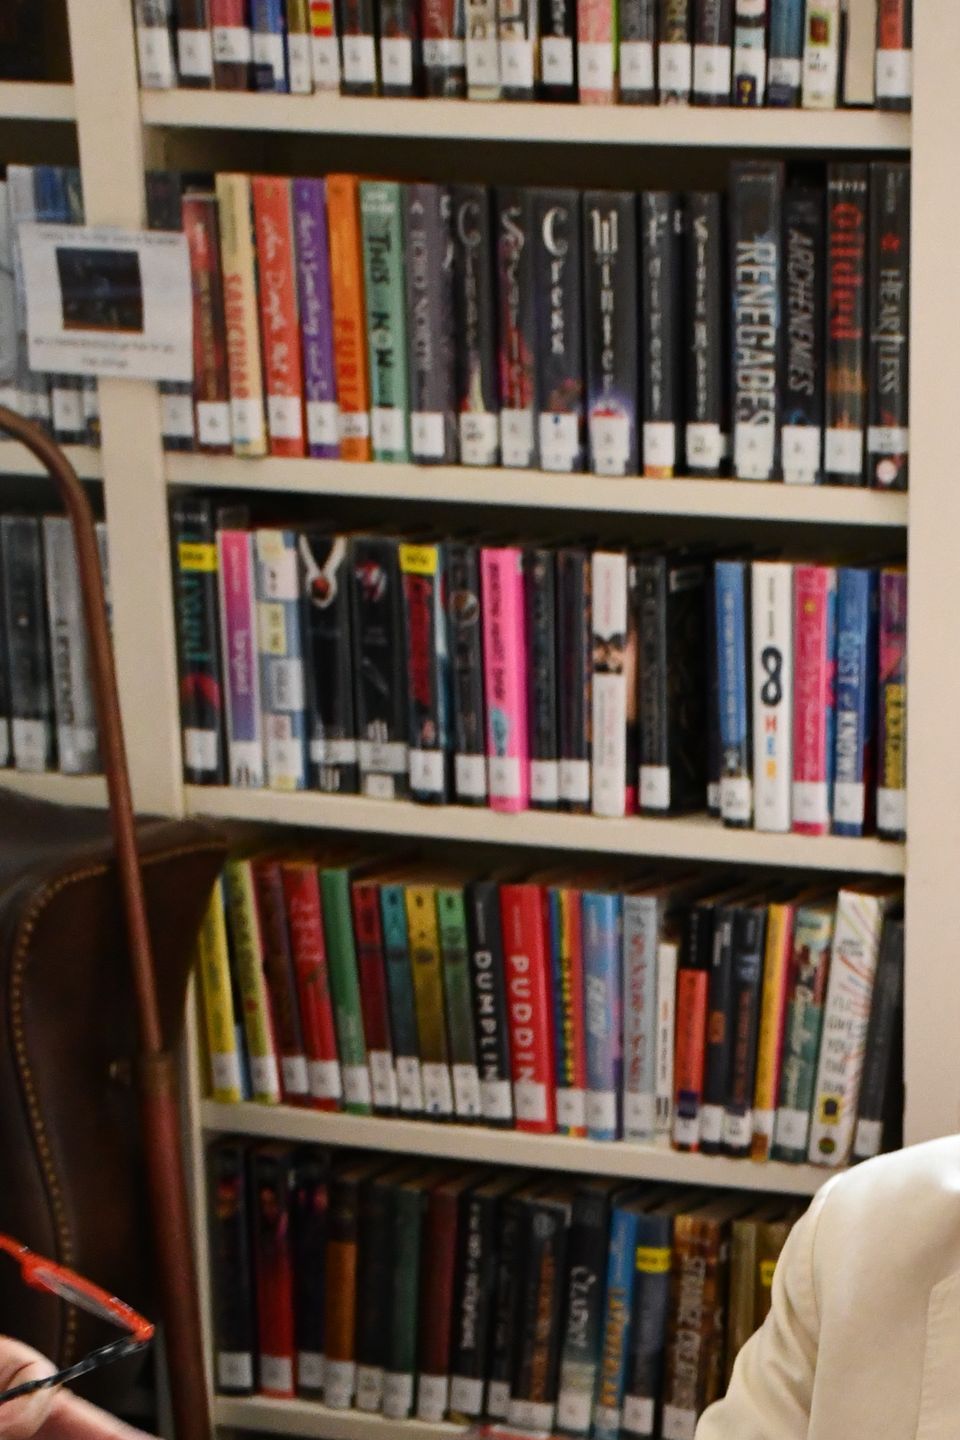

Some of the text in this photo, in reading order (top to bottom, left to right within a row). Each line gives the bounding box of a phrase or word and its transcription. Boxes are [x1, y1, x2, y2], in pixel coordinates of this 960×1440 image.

[735, 240, 777, 427] RENEGADES
[787, 228, 815, 396] ARCHENEMIES
[873, 268, 906, 395] HEARTLESS
